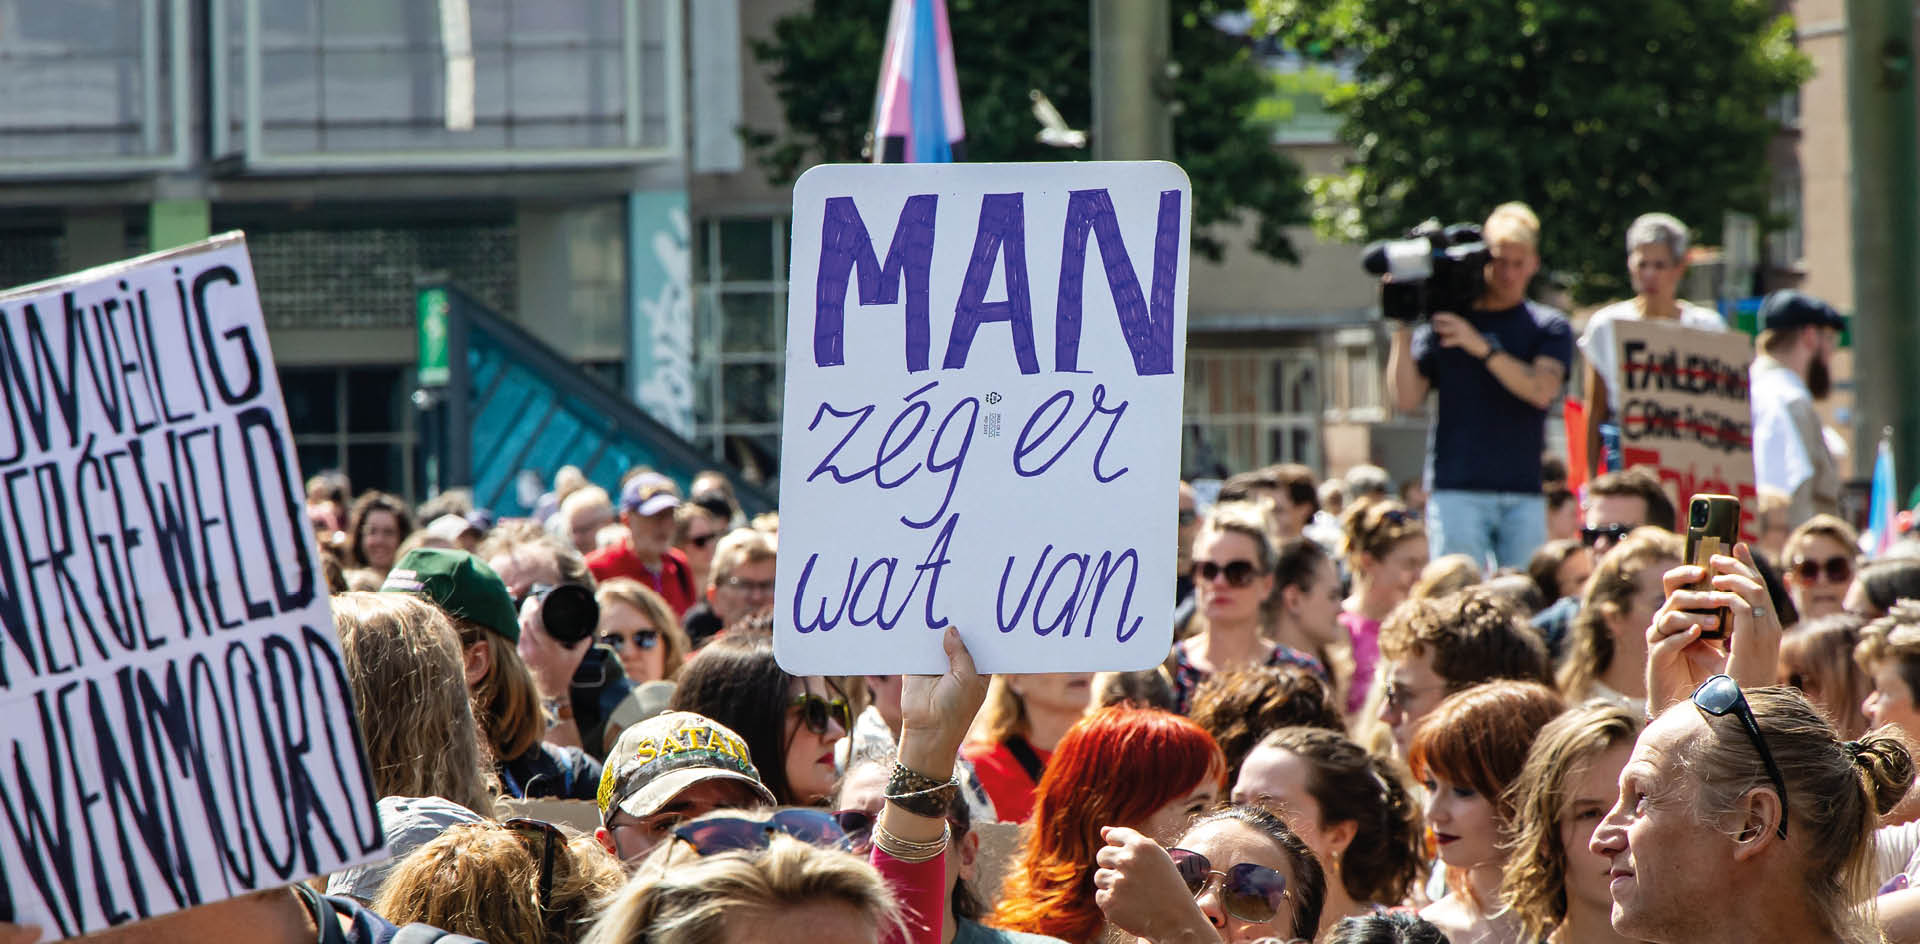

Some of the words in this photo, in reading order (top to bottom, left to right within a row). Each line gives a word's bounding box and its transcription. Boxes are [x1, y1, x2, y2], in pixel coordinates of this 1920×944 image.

[814, 188, 1182, 376] MAN
[808, 381, 980, 529] zég
[1013, 384, 1129, 484] er
[793, 513, 959, 634] wat
[996, 544, 1144, 644] van
[637, 725, 749, 767] SATAN
